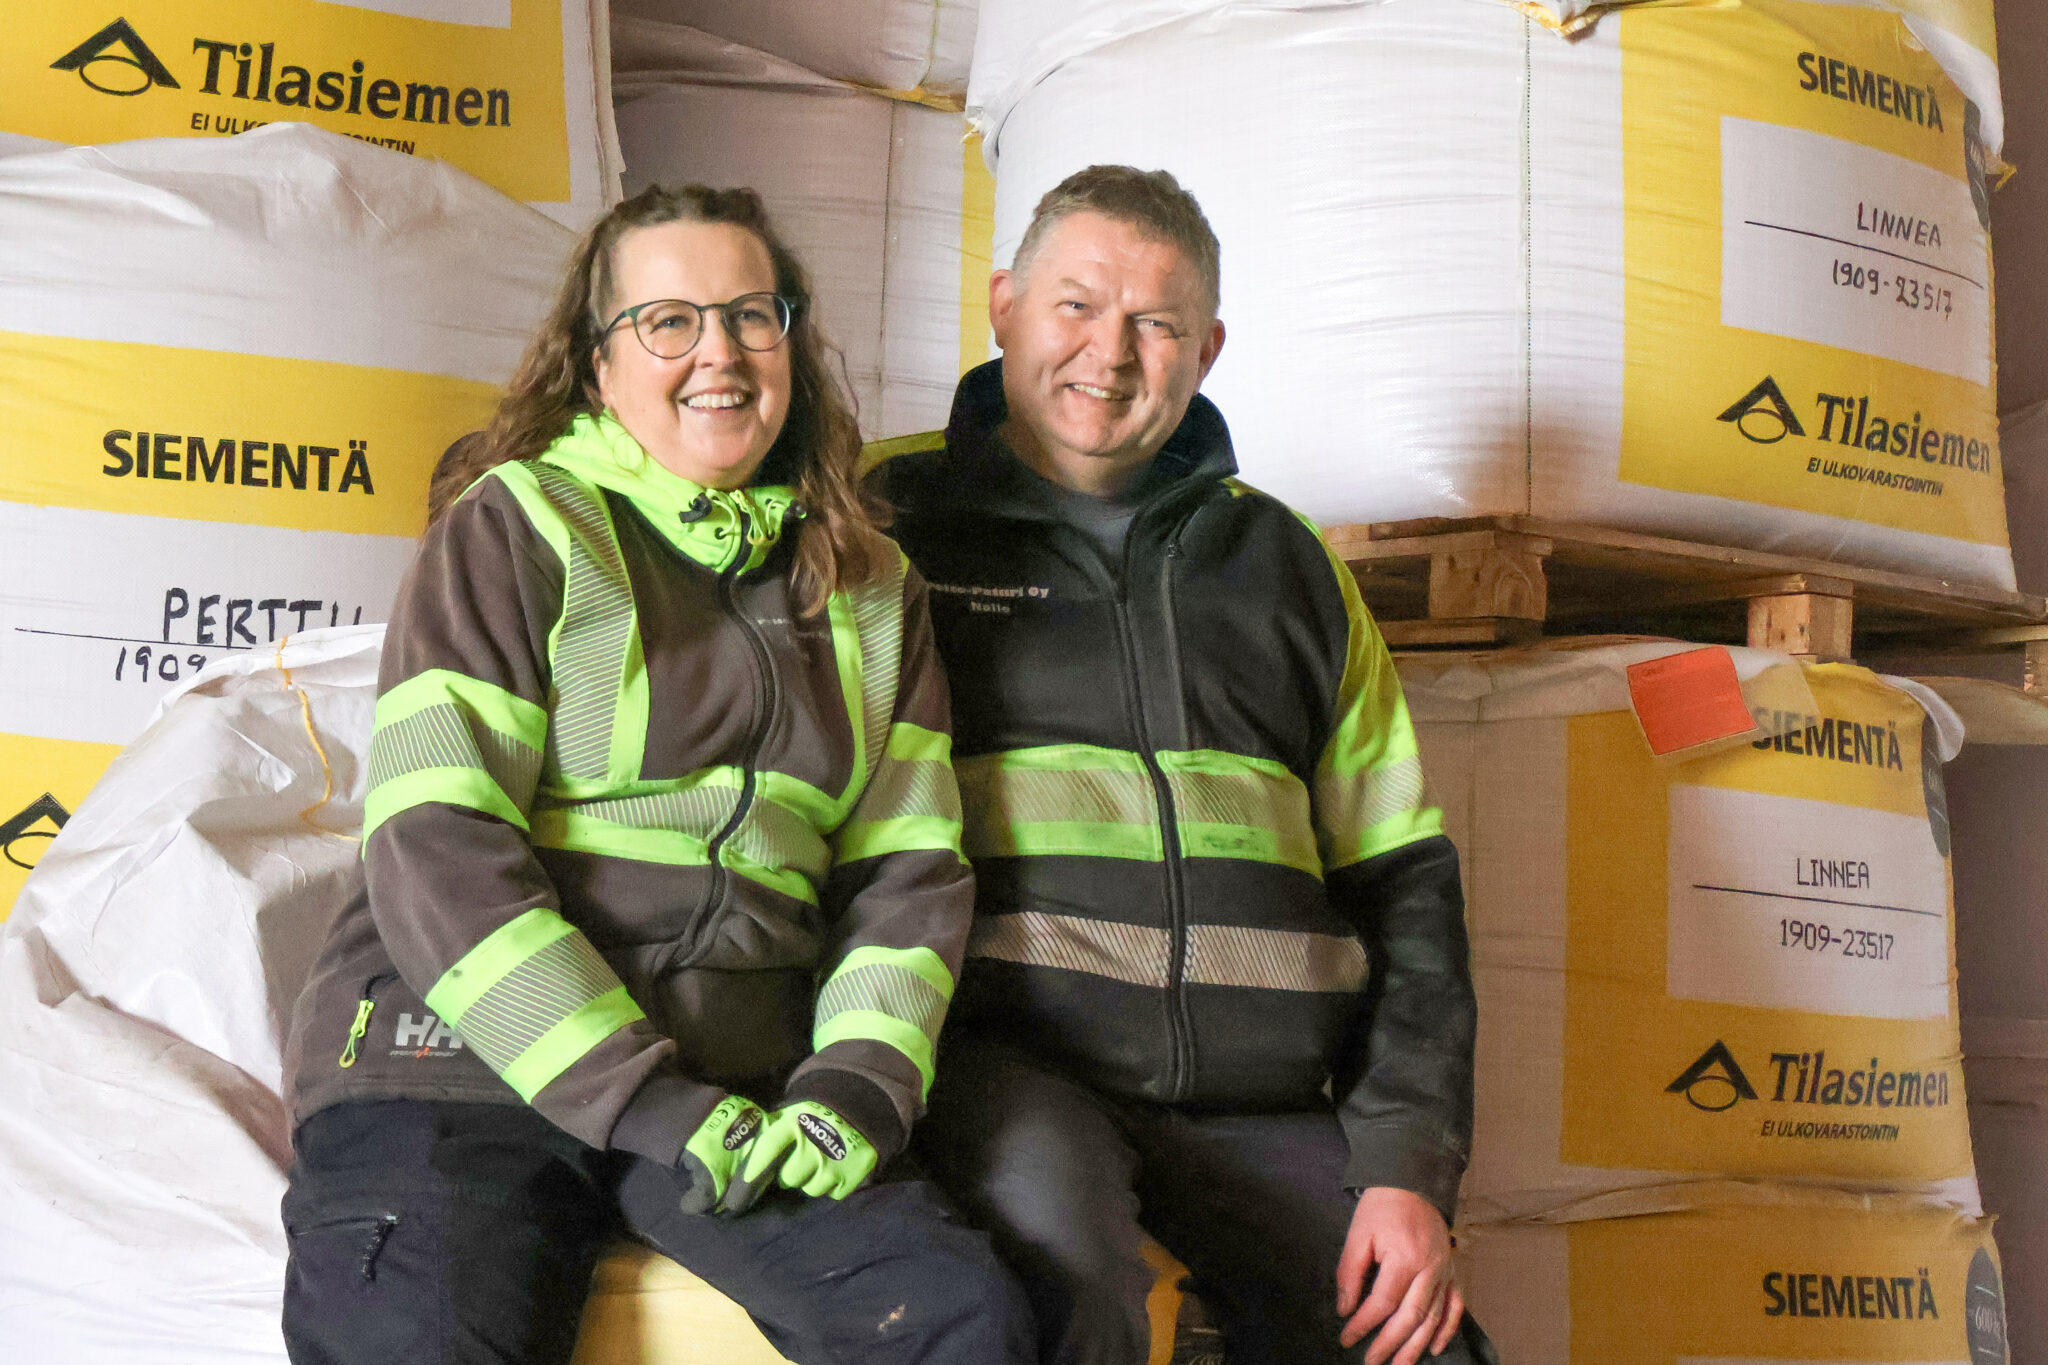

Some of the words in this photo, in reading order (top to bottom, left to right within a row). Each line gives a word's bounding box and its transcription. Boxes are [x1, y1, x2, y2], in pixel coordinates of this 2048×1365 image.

[191, 37, 511, 127] Tilasiemen
[1797, 51, 1944, 133] SIEMENTÄ
[191, 112, 210, 131] EI
[1856, 202, 1941, 250] LINNEA
[1816, 393, 1991, 474] Tilasiemen
[102, 429, 374, 495] SIEMENTÄ
[1806, 456, 1822, 473] EI
[1822, 459, 1944, 496] ULKOVARASTOINTIN
[1752, 706, 1903, 771] SIEMENTÄ
[1797, 857, 1870, 889] LINNEA
[1780, 918, 1894, 960] 1909-23517
[1769, 1050, 1949, 1107] Tilasiemen
[799, 1114, 846, 1160] STRONG
[1761, 1120, 1776, 1137] EI
[1777, 1120, 1899, 1141] ULKOVARASTOINTIN
[1762, 1268, 1939, 1320] SIEMENTÄ
